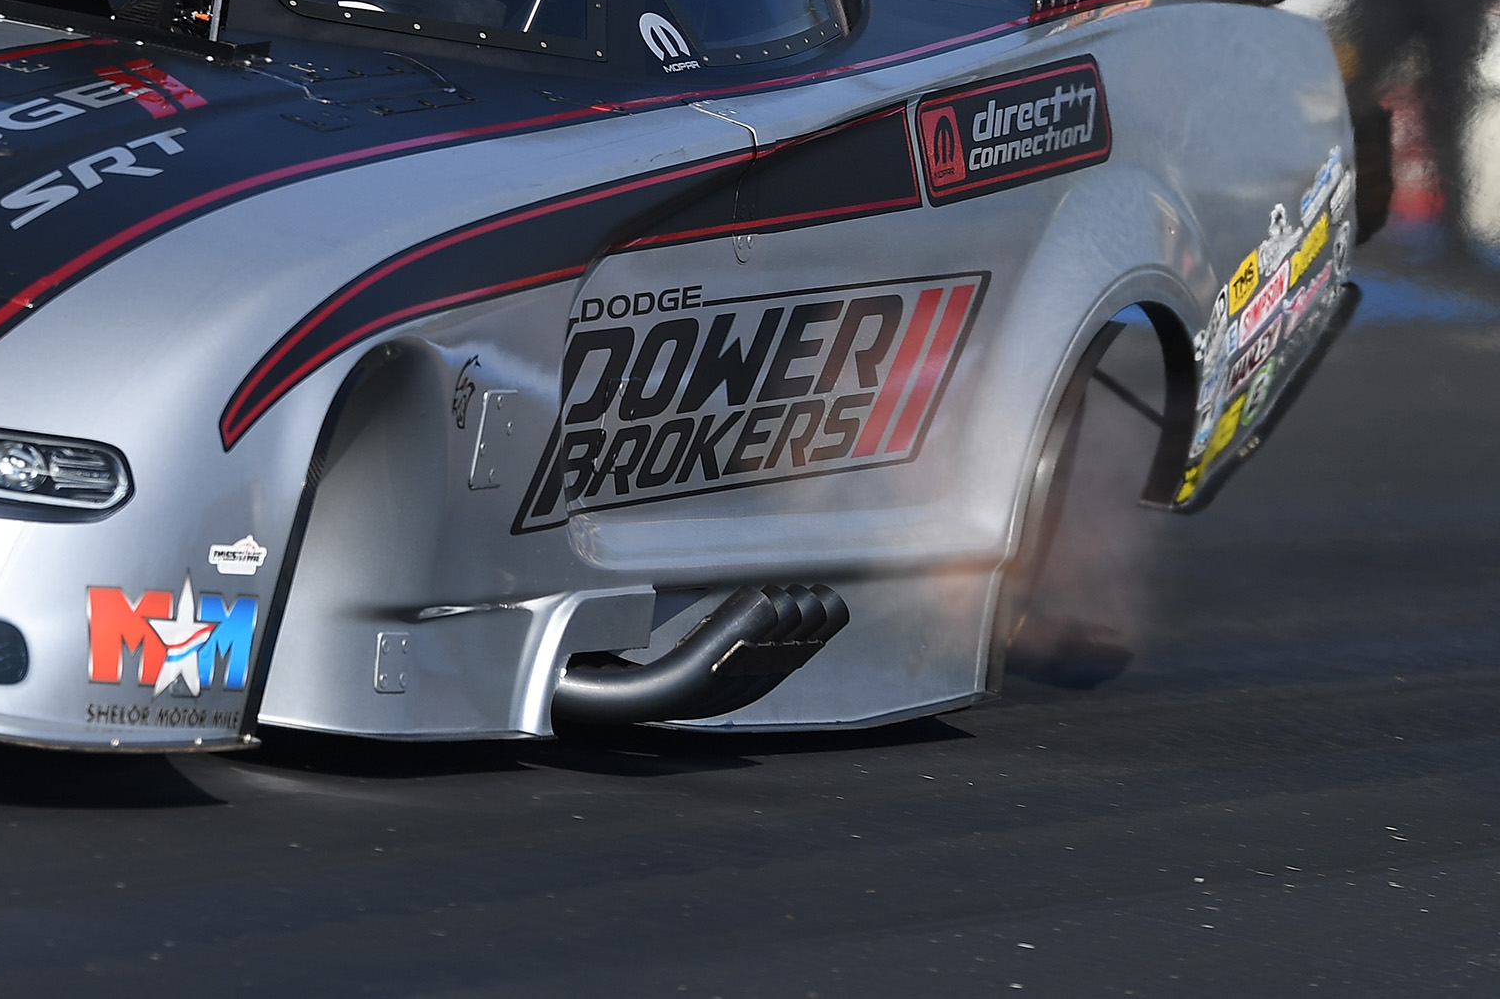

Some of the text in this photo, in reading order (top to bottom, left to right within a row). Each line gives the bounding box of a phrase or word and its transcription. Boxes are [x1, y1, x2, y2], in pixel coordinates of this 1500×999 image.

[663, 60, 701, 75] MOPAR
[972, 85, 1076, 143] direct
[968, 118, 1095, 172] connection
[0, 127, 188, 231] SRT
[581, 286, 703, 323] DODGE
[1233, 261, 1255, 299] TMS
[564, 295, 904, 426] POWER
[530, 392, 877, 518] BROKERS
[86, 703, 240, 729] SHELOR MOTOR MILE
